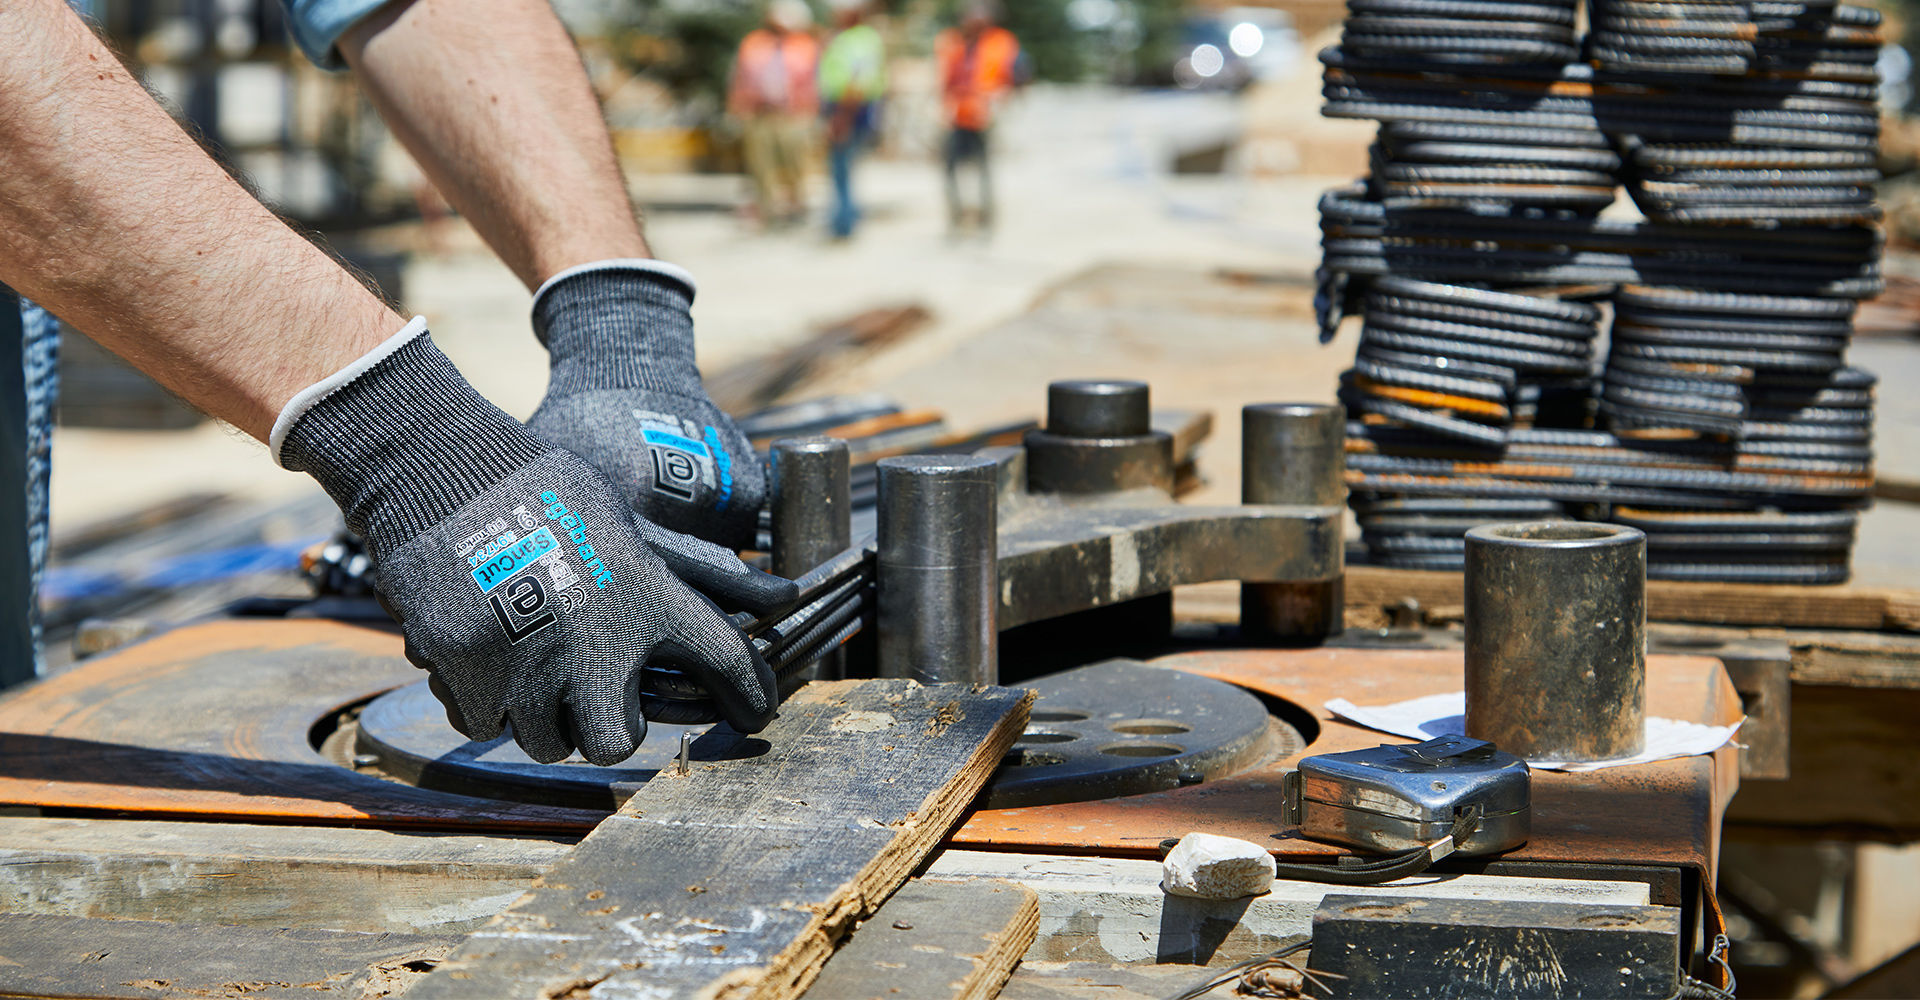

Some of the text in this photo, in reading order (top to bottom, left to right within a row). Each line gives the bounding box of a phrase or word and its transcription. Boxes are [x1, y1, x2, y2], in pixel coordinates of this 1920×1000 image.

[456, 530, 487, 554] Turkey
[467, 530, 516, 566] 391734
[478, 532, 550, 582] SanCut
[541, 490, 614, 590] egebant
